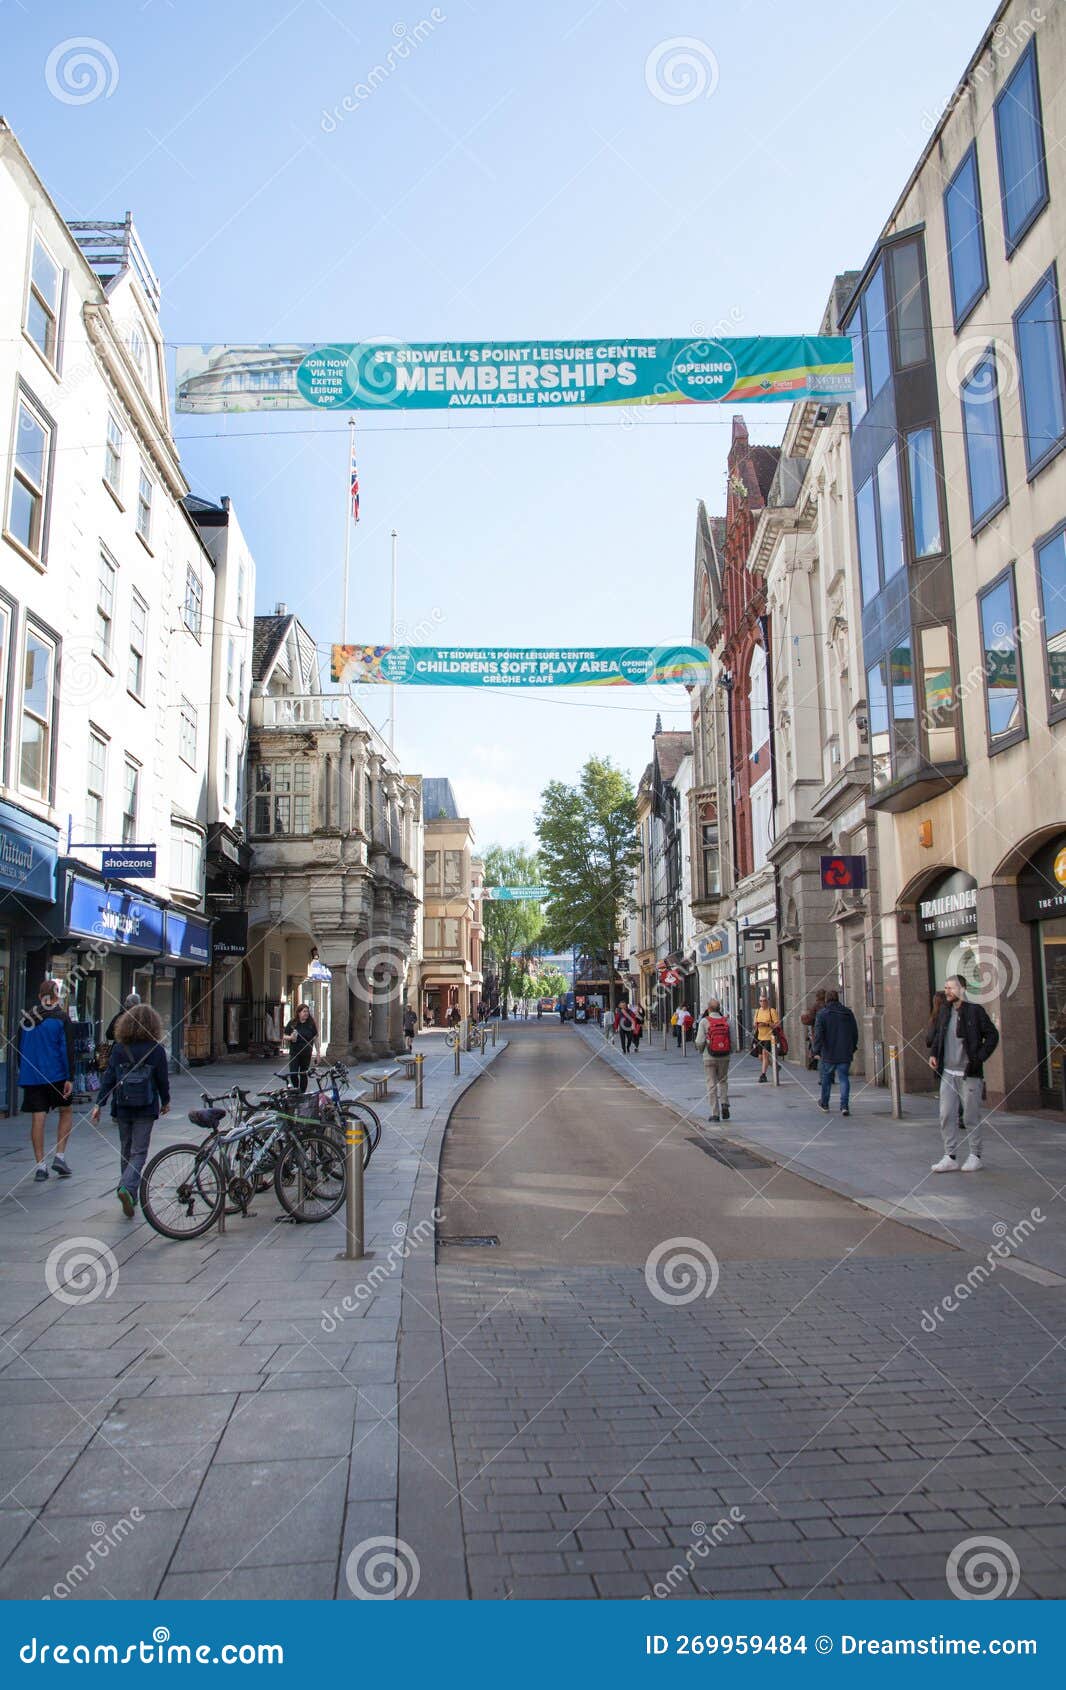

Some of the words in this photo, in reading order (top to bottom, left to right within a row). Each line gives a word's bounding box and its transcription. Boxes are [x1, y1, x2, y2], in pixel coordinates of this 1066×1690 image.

[375, 351, 395, 362] ST
[397, 350, 478, 363] SIDWELL'S
[481, 349, 530, 361] POINT
[533, 348, 593, 360] LEISURE
[596, 346, 656, 358] CENTRE
[305, 360, 326, 368] JOIN
[327, 360, 349, 368] NOW
[677, 362, 732, 373] OPENING
[311, 369, 326, 377] VIA
[327, 369, 343, 377] THE
[396, 361, 637, 391] MEMBERSHIPS
[311, 378, 343, 386] EXETER
[688, 375, 723, 385] SOON
[318, 395, 336, 403] APP
[449, 391, 534, 406] AVAILABLE
[538, 390, 586, 404] NOW!
[438, 652, 450, 660] ST
[450, 651, 496, 660] SIDWELL'S
[497, 652, 525, 660] POINT
[525, 652, 560, 660] LEISURE
[561, 651, 595, 660] CENTRE
[416, 661, 499, 673] CHILDRENS
[501, 661, 538, 673] SOFT
[540, 661, 578, 673] PLAY
[580, 660, 620, 673] AREA
[482, 673, 521, 683] CRÈCHE
[528, 673, 554, 683] CAFÉ
[0, 832, 33, 870] hittard
[104, 858, 153, 868] shoezone
[1039, 898, 1051, 909] THE
[924, 922, 936, 932] THE
